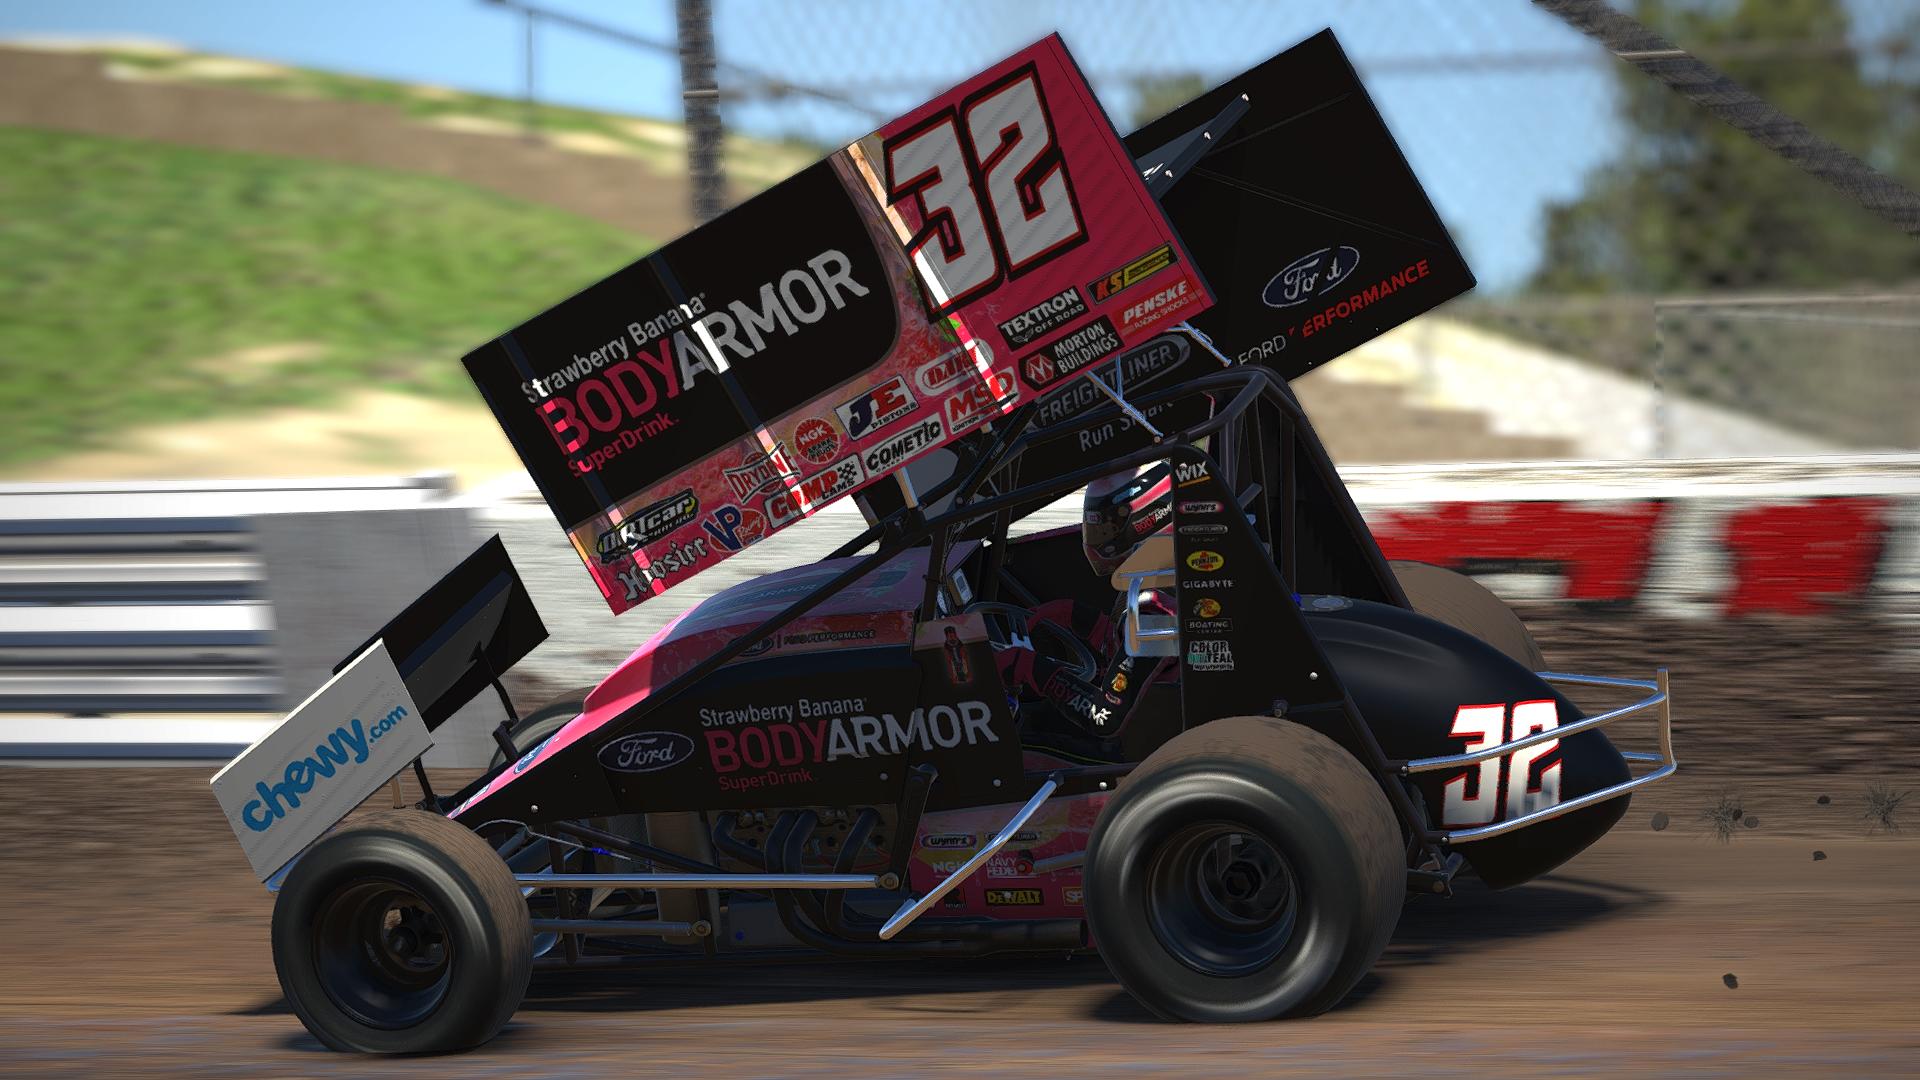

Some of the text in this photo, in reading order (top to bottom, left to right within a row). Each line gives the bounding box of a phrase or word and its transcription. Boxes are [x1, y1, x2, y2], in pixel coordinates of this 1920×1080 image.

[883, 60, 1089, 323] 32
[1283, 256, 1343, 300] Ford
[1287, 258, 1431, 338] ERFORMANCE
[1001, 289, 1080, 337] TEXTRON
[1034, 303, 1086, 335] OFF ROAD
[1122, 280, 1187, 324] PENSKE
[535, 248, 870, 455] BODYARMOR
[1053, 321, 1106, 358] MORTON
[1056, 334, 1119, 375] BUILDINGS
[1237, 335, 1287, 364] FORD
[521, 334, 630, 404] Strawberry
[849, 380, 907, 438] JE
[949, 372, 1014, 422] MSD
[799, 424, 828, 446] NGK
[866, 421, 941, 471] COMETIC
[1078, 424, 1115, 452] Run
[821, 480, 855, 501] CAMS
[1175, 461, 1208, 482] WIX
[771, 470, 839, 520] COMP
[701, 505, 742, 551] VP
[1182, 579, 1234, 589] GIGABYTE
[1189, 621, 1229, 629] BOATING
[699, 698, 865, 727] Strawberry Banana
[617, 738, 675, 767] Ford
[703, 700, 1000, 773] BODYARMOR
[242, 705, 409, 832] chewy.com
[1441, 700, 1562, 830] 32
